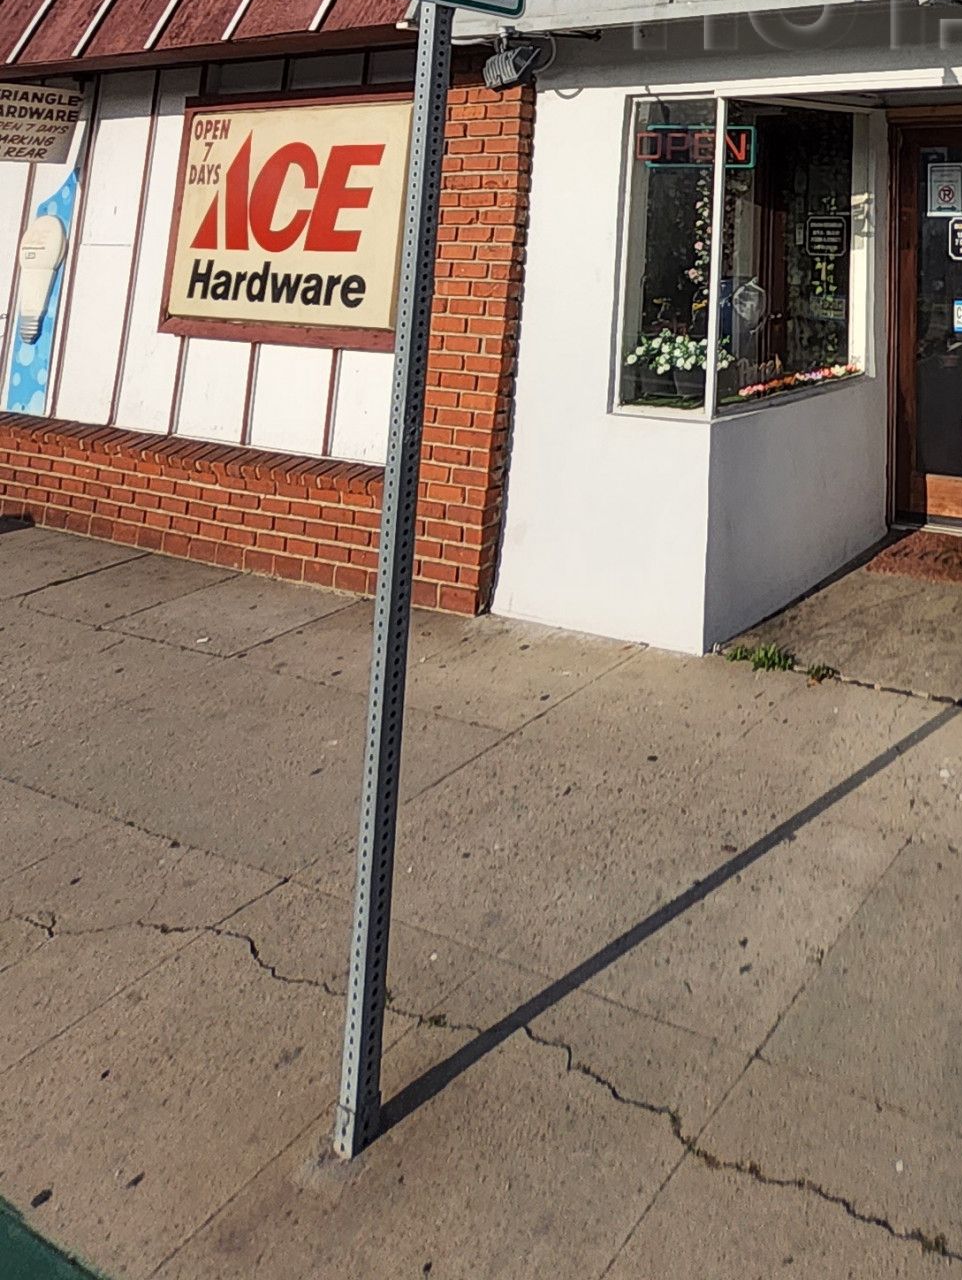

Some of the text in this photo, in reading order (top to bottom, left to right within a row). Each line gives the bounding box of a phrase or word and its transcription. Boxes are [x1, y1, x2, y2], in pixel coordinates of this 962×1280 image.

[0, 89, 81, 107] RIANGLE
[26, 123, 36, 131] 7
[36, 124, 70, 135] DAYS
[194, 119, 232, 141] OPEN
[3, 146, 48, 159] REAR
[203, 142, 214, 163] 7
[636, 131, 747, 161] OPEN
[188, 163, 222, 185] DAYS
[189, 128, 386, 253] ACE
[186, 258, 367, 309] Hardware
